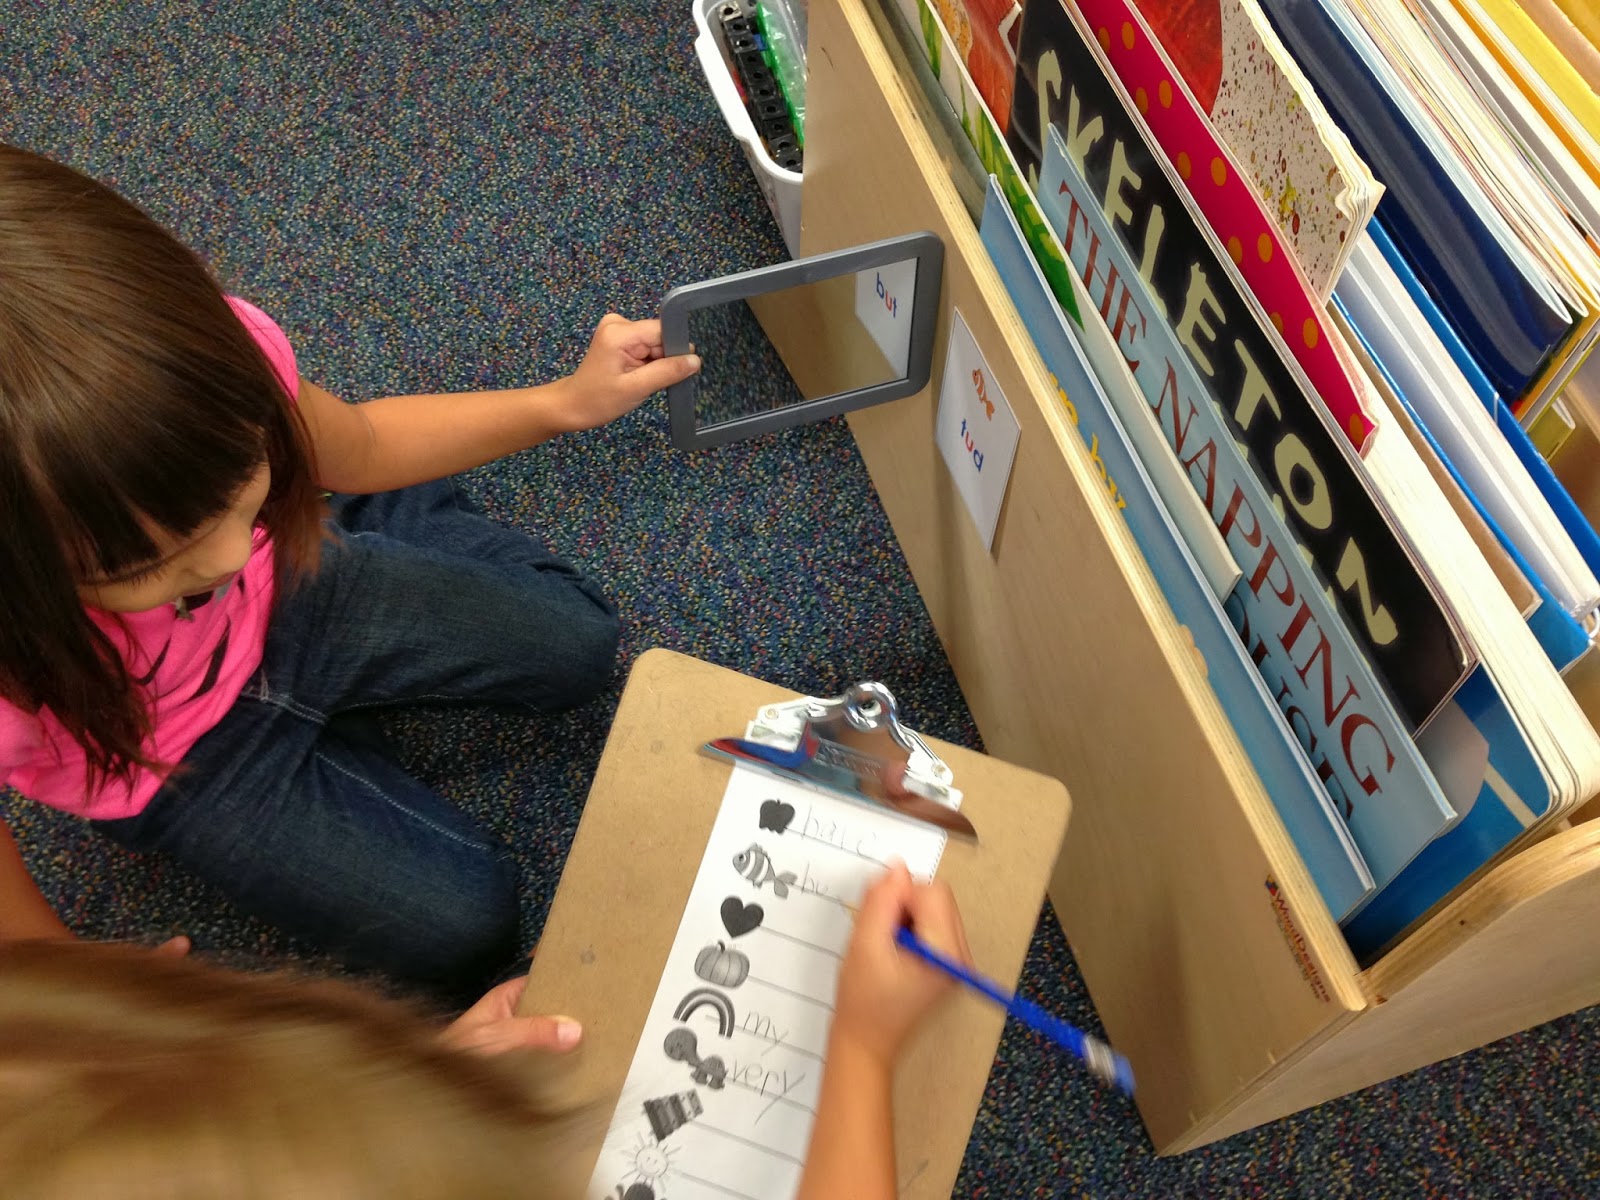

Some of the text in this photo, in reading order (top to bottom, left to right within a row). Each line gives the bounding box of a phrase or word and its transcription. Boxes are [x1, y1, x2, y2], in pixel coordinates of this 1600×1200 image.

[876, 271, 898, 319] but
[1058, 179, 1147, 374] THE
[1151, 355, 1396, 798] NAPPING
[742, 1010, 790, 1057] my
[732, 1058, 807, 1126] very
